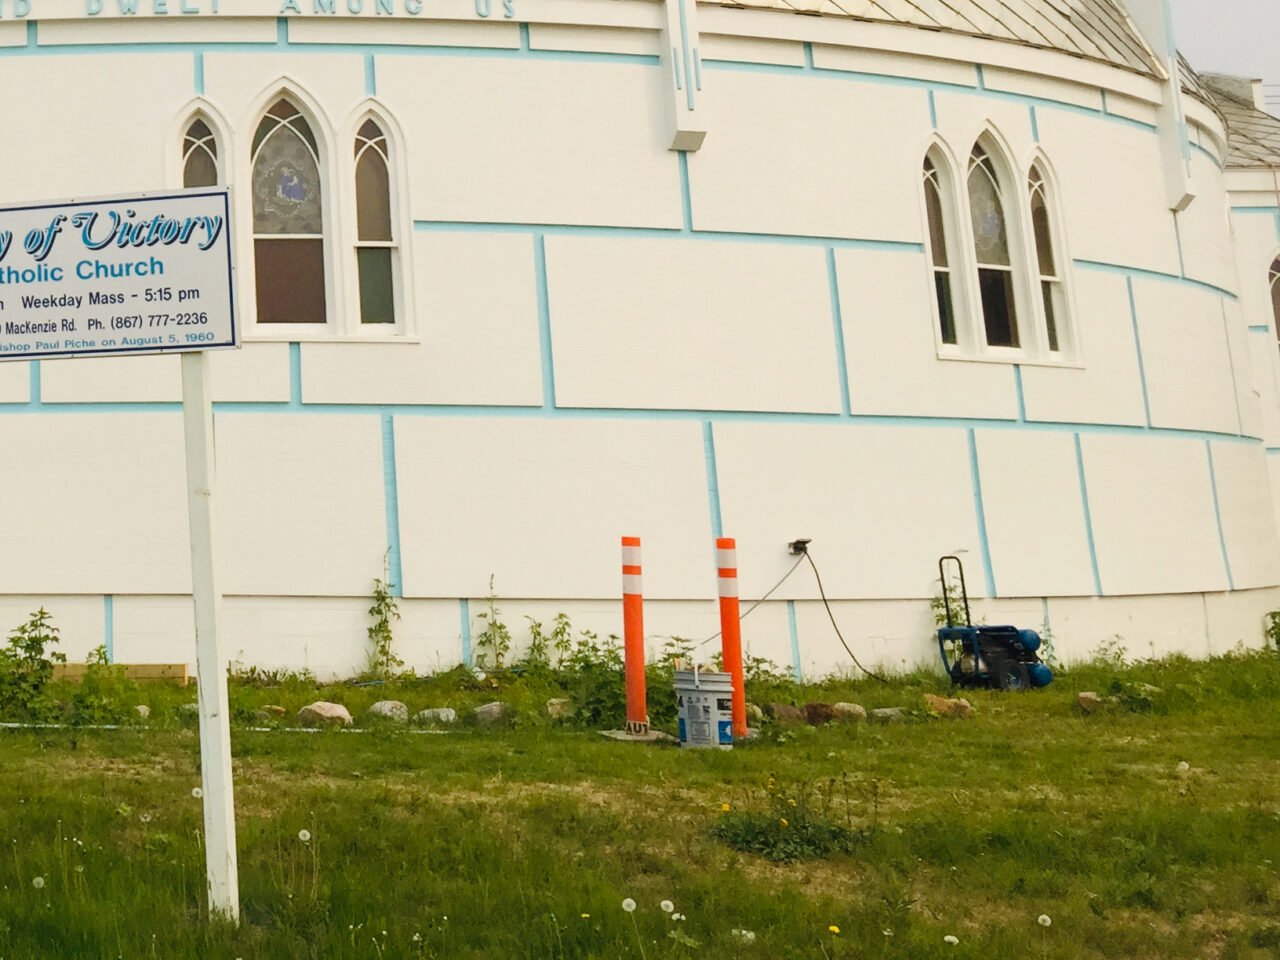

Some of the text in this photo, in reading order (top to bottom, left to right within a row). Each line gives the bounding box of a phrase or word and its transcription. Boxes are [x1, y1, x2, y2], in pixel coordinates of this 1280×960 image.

[24, 214, 67, 262] of
[71, 209, 223, 251] Victory
[76, 256, 165, 280] Church
[21, 293, 83, 309] Weekday
[89, 291, 125, 306] Mass
[144, 287, 173, 302] 5:15
[178, 289, 200, 302] pm
[5, 319, 57, 335] MacKenzie
[61, 318, 78, 332] Rd.
[87, 318, 106, 331] Ph.
[110, 313, 143, 330] (867)
[148, 312, 208, 327] 777-2236
[35, 341, 60, 351] Paul
[101, 339, 116, 347] on
[121, 335, 163, 347] August
[185, 332, 215, 343] 1960
